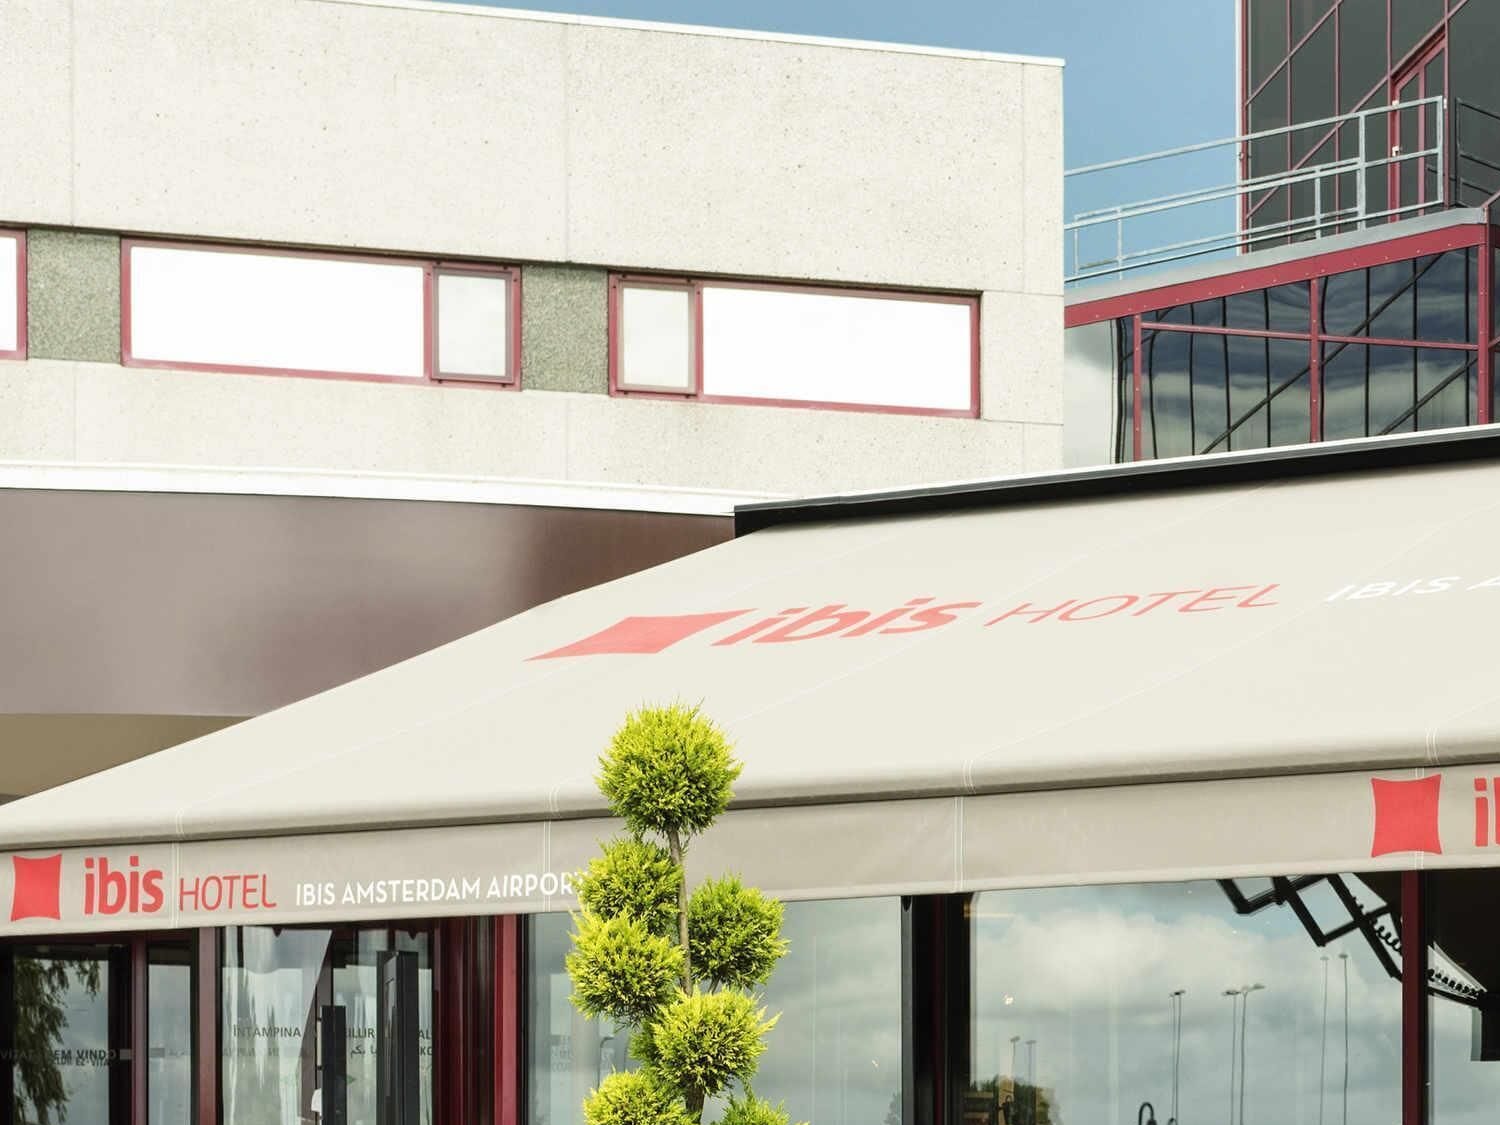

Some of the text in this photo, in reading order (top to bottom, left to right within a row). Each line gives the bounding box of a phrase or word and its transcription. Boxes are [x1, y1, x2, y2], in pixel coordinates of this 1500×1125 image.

[711, 582, 1280, 647] ibis HOTEL
[1325, 575, 1461, 602] IBIS
[83, 855, 164, 916] ibis
[178, 873, 277, 912] HOTEL
[296, 882, 336, 906] IBIS
[341, 877, 481, 905] AMSTERDAM
